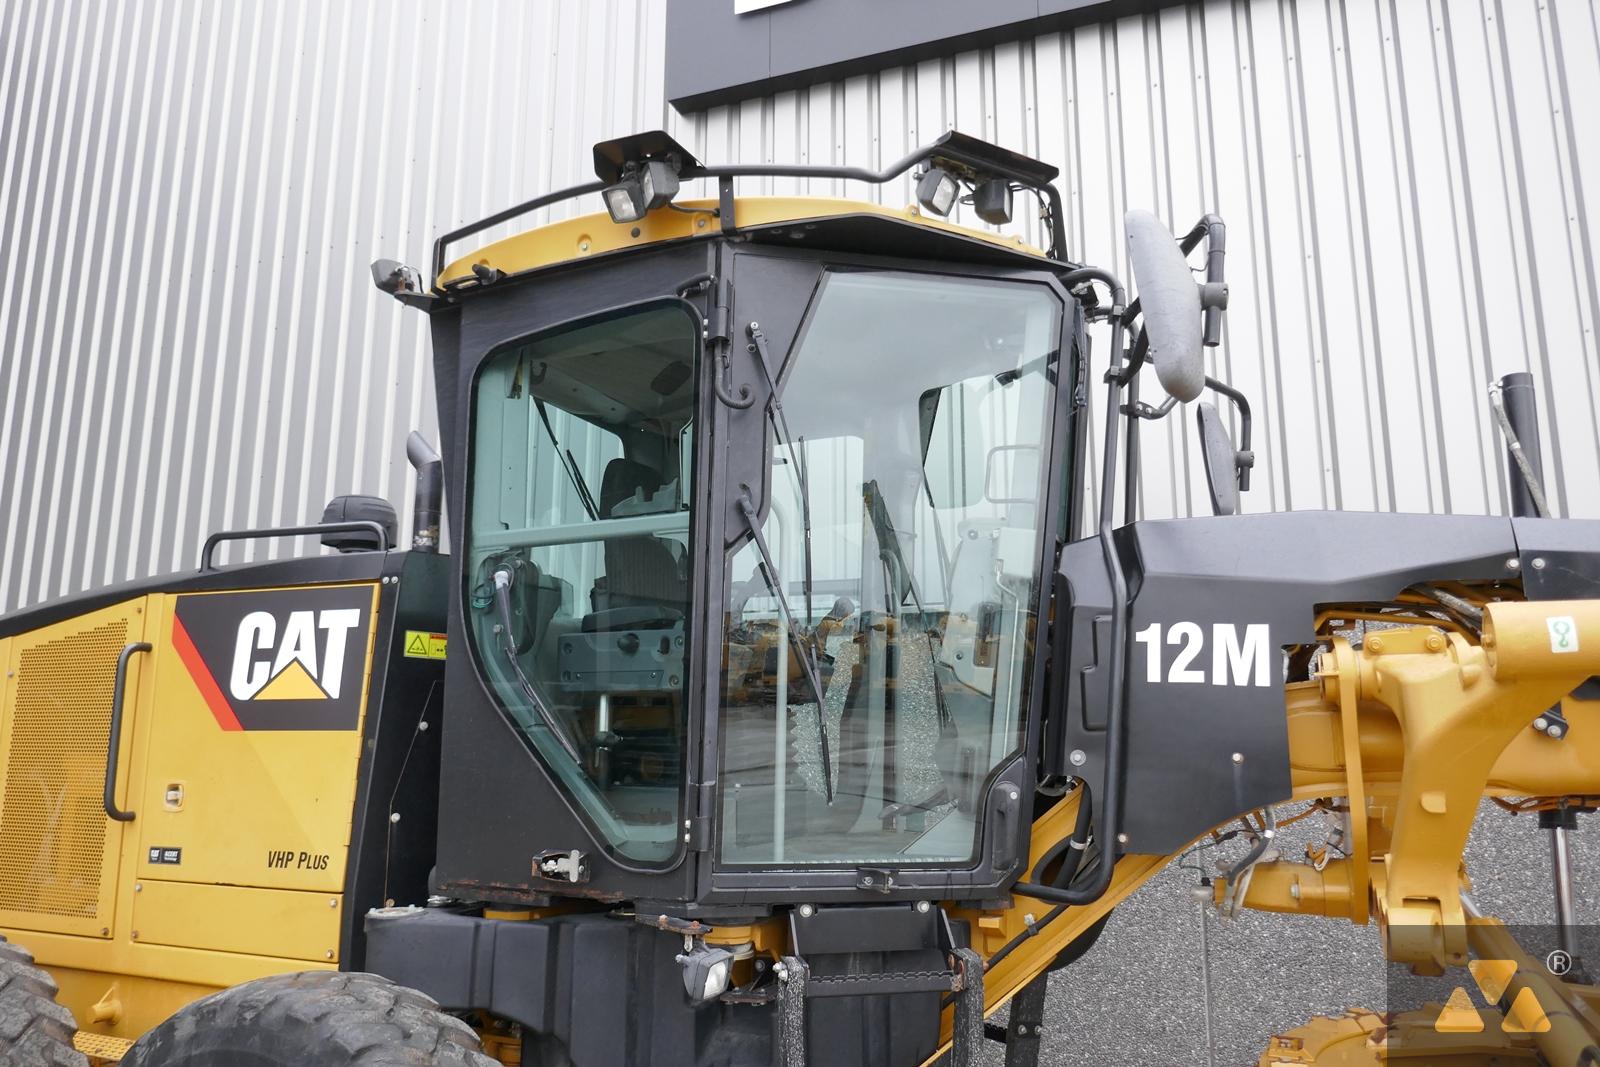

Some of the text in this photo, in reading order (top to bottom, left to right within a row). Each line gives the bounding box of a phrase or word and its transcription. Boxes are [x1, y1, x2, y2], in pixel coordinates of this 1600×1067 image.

[230, 609, 361, 701] CAT
[1135, 621, 1271, 687] 12M
[268, 850, 330, 870] VHP PLUS
